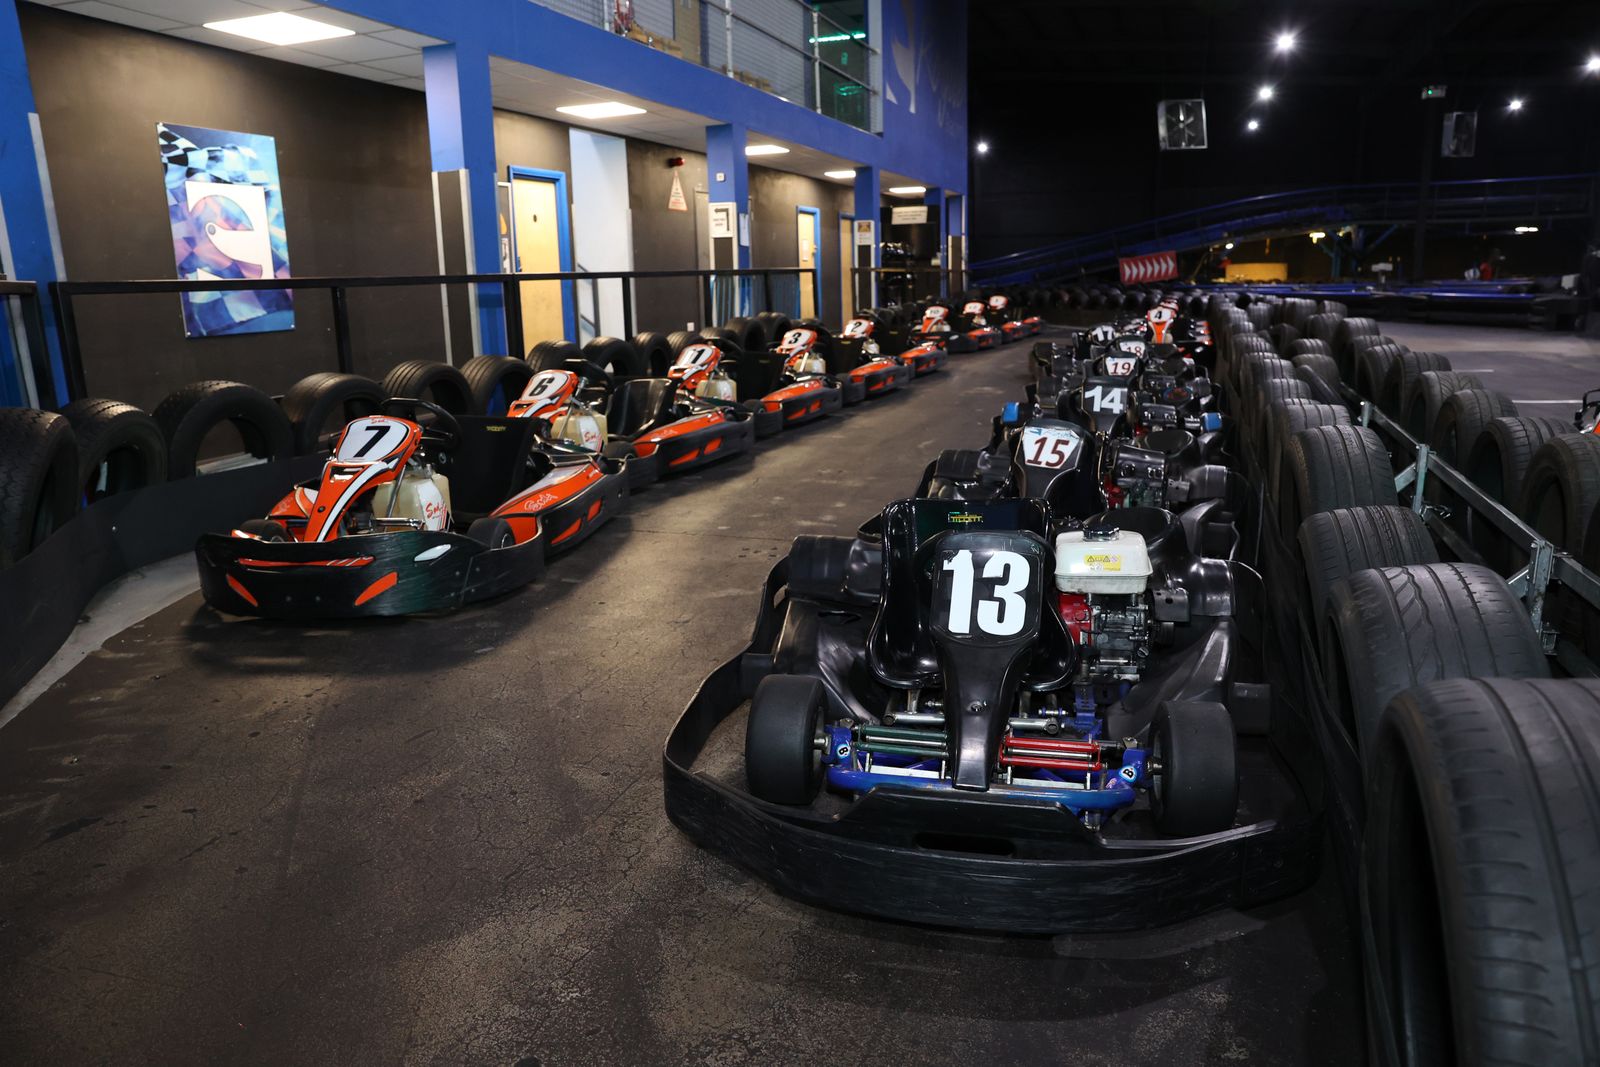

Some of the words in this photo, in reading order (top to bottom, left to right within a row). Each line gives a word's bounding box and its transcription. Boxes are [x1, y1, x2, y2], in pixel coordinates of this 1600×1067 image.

[1154, 310, 1163, 320] 4
[851, 321, 863, 333] 2
[1092, 325, 1115, 341] 17
[791, 332, 802, 344] 3
[1110, 362, 1132, 375] 19
[529, 377, 554, 397] 6
[1085, 386, 1123, 414] 14
[353, 426, 391, 458] 7
[1026, 436, 1070, 467] 15
[943, 549, 1030, 636] 13
